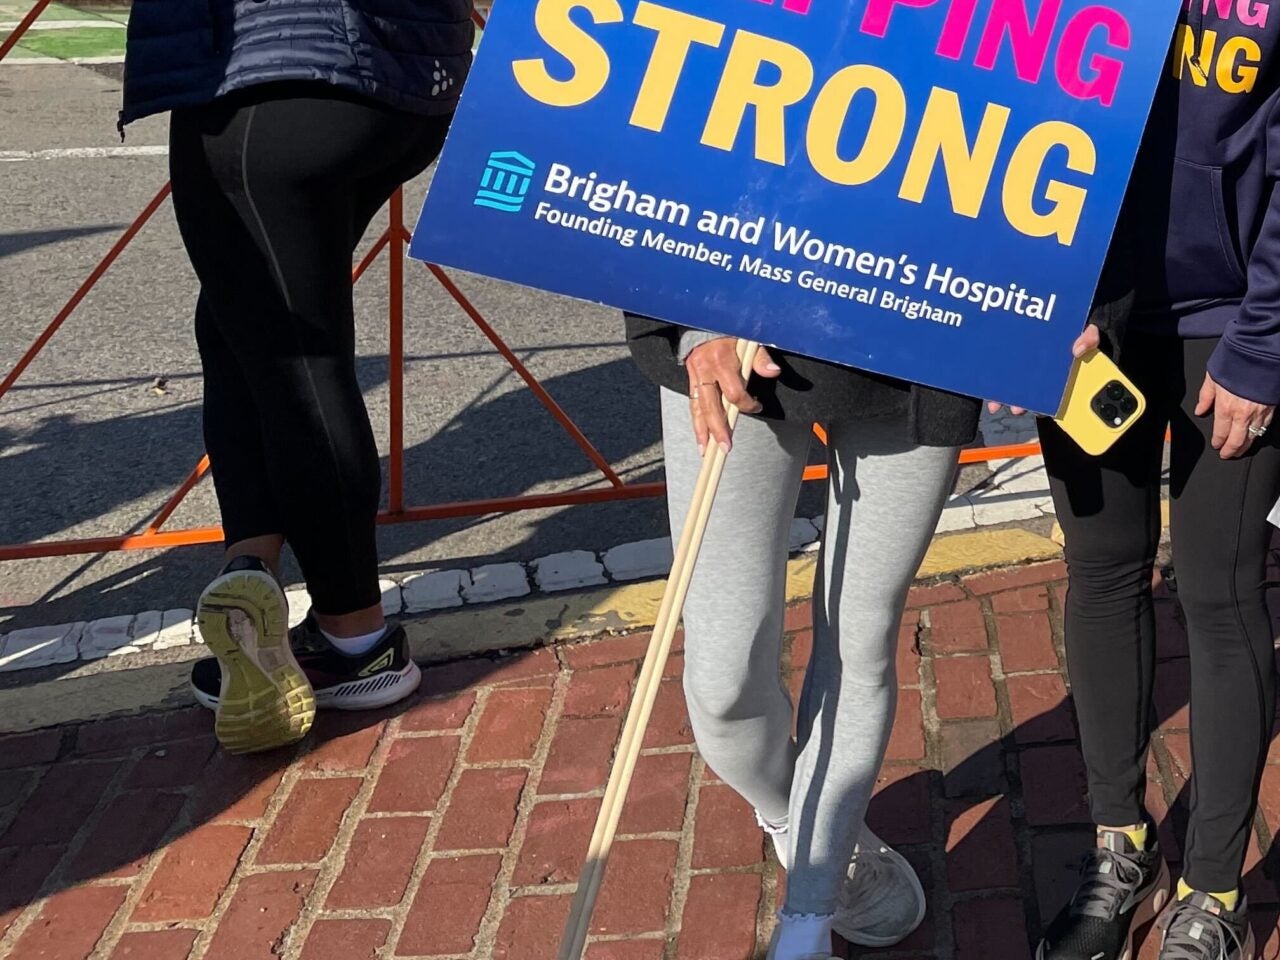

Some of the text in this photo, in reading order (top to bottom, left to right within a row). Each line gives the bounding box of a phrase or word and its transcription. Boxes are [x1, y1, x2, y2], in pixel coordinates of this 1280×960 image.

[534, 202, 963, 327] Founding Member, Mass General Brigham
[544, 162, 1057, 321] Brigham and Women's Hospital
